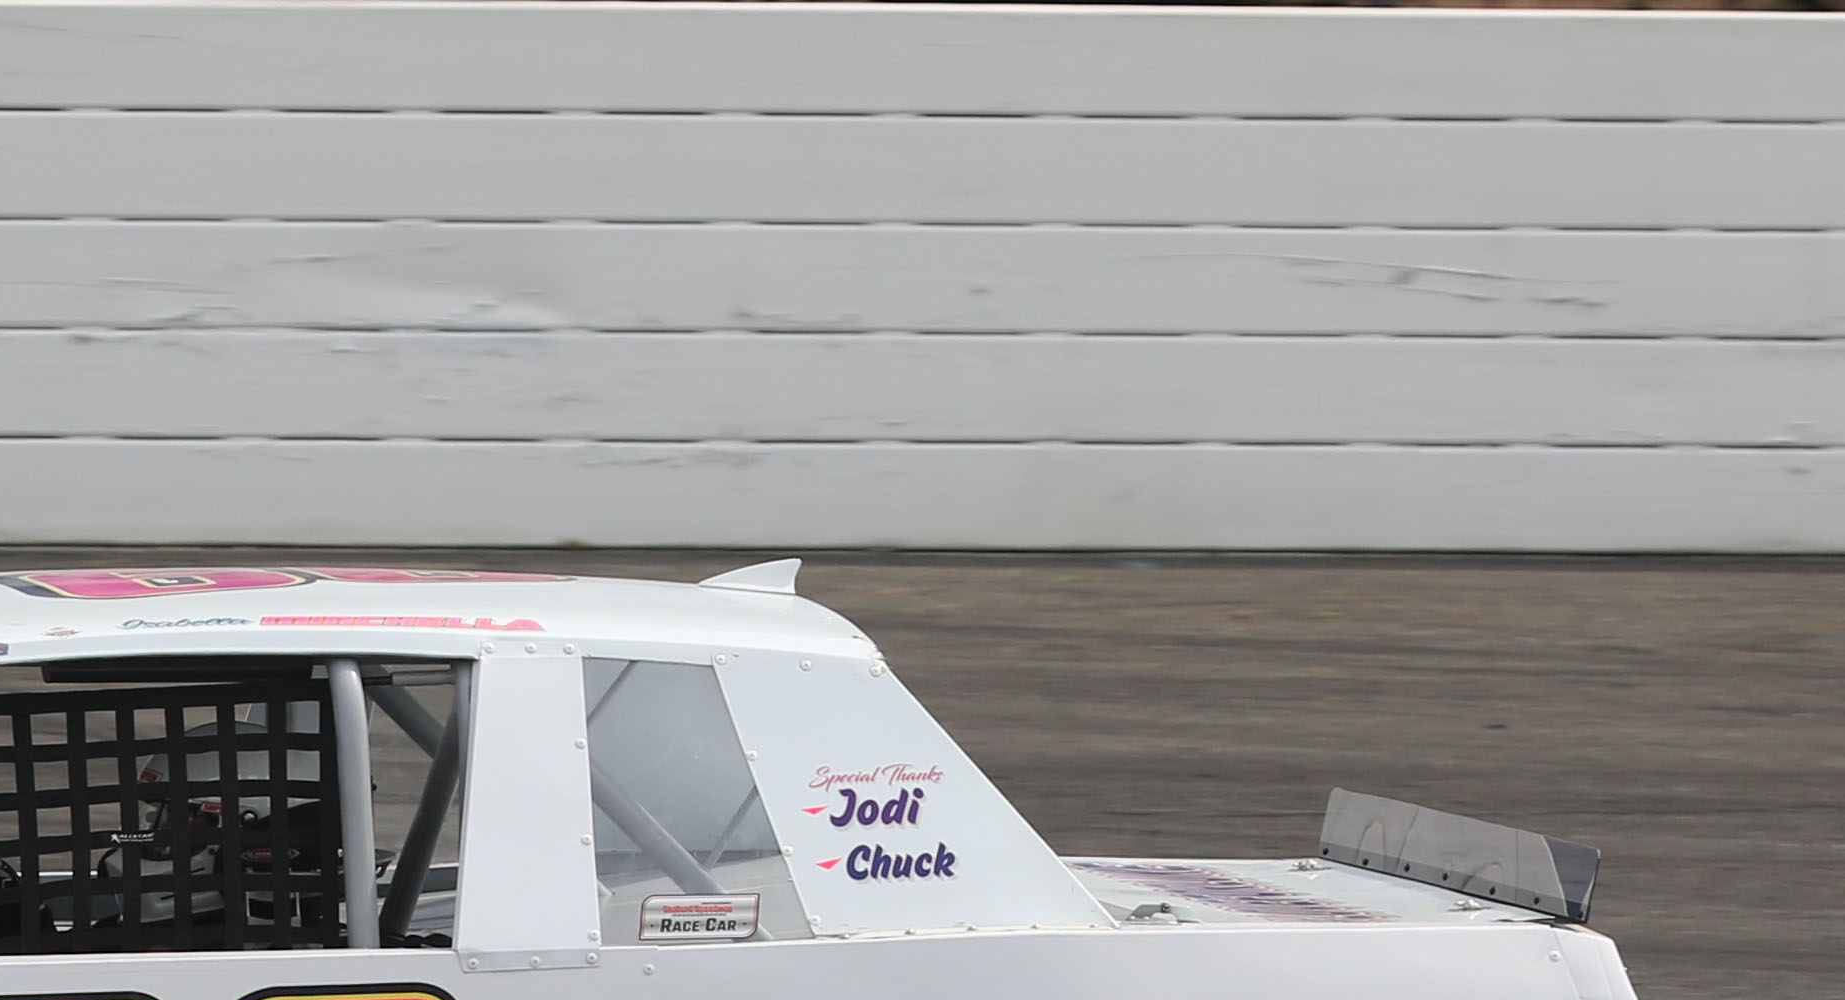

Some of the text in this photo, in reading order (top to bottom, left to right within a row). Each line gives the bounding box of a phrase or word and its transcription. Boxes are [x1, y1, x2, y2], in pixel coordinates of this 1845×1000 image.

[808, 762, 945, 791] Special Thanks
[829, 787, 925, 828] Jodi
[846, 841, 955, 880] Chuck
[660, 917, 737, 932] RACE CAR
